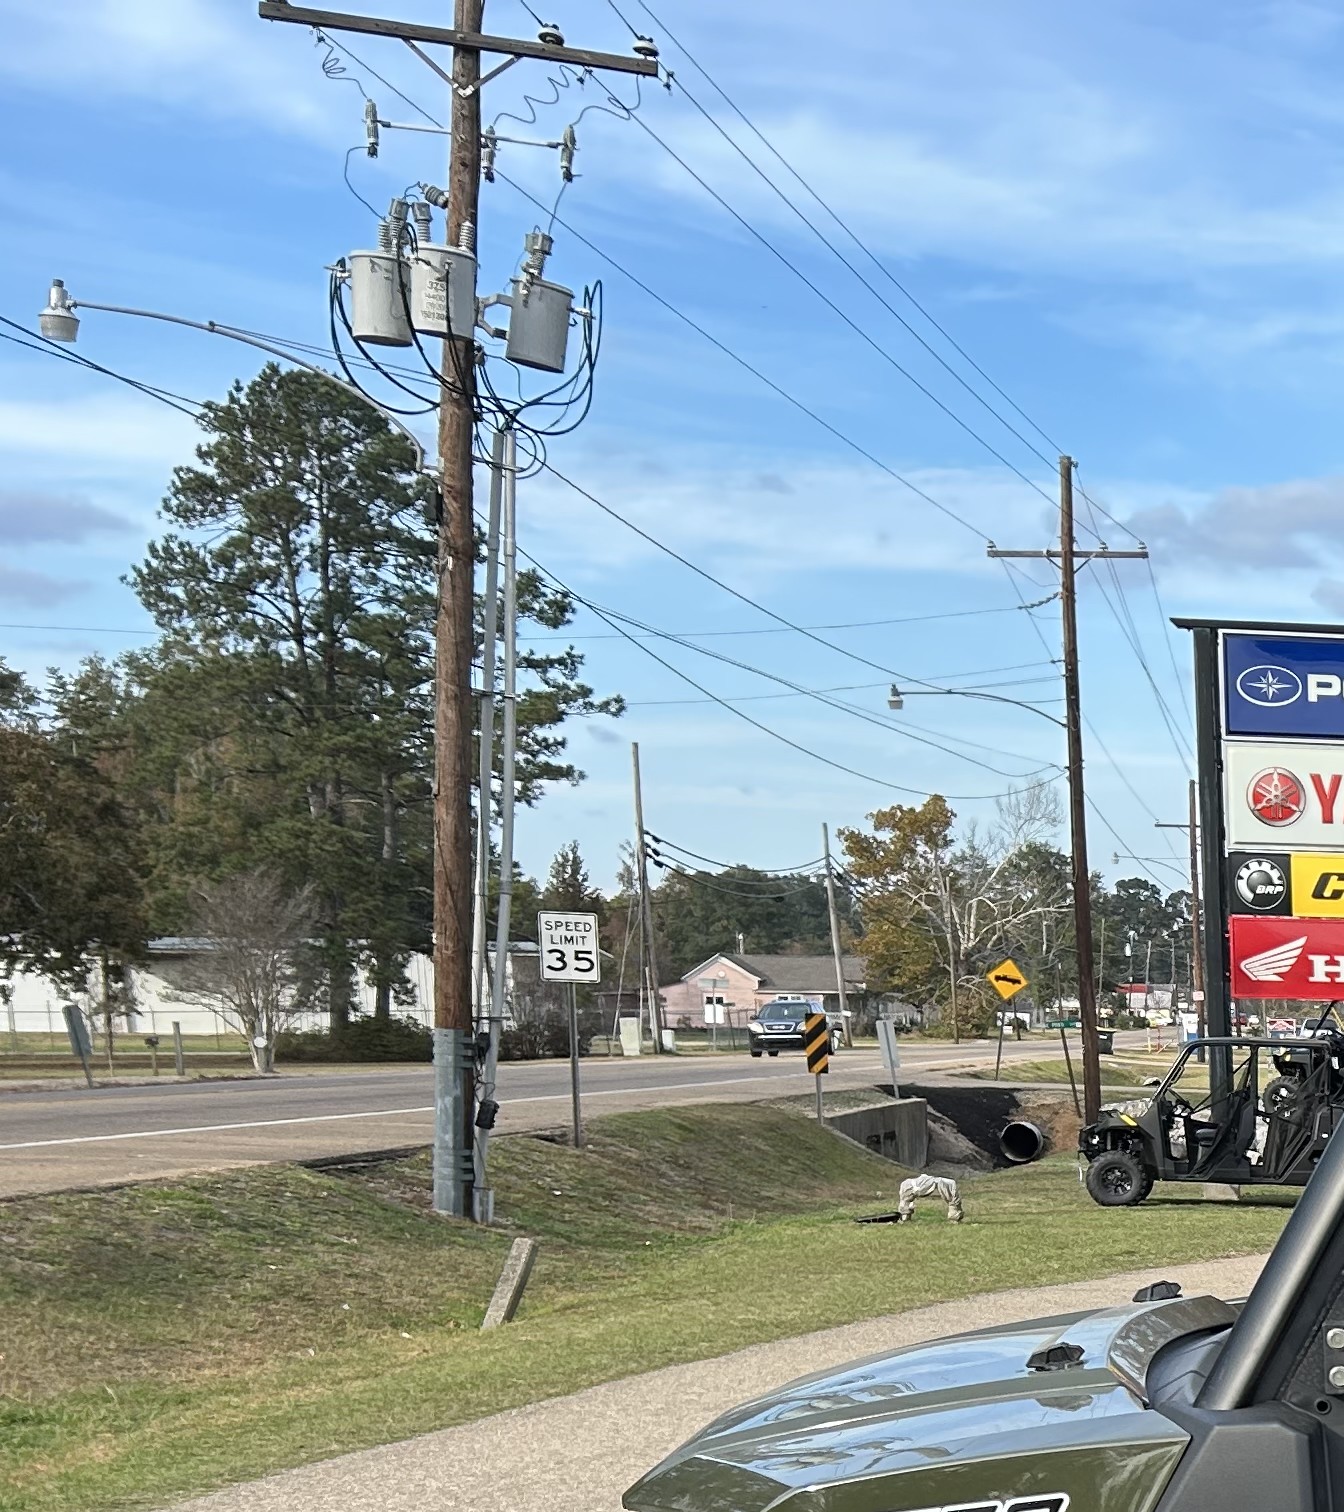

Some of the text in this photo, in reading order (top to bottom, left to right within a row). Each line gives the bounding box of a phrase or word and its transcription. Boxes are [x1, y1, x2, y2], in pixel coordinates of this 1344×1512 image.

[544, 920, 592, 932] SPEED
[550, 934, 587, 946] LIMIT
[546, 948, 595, 973] 35
